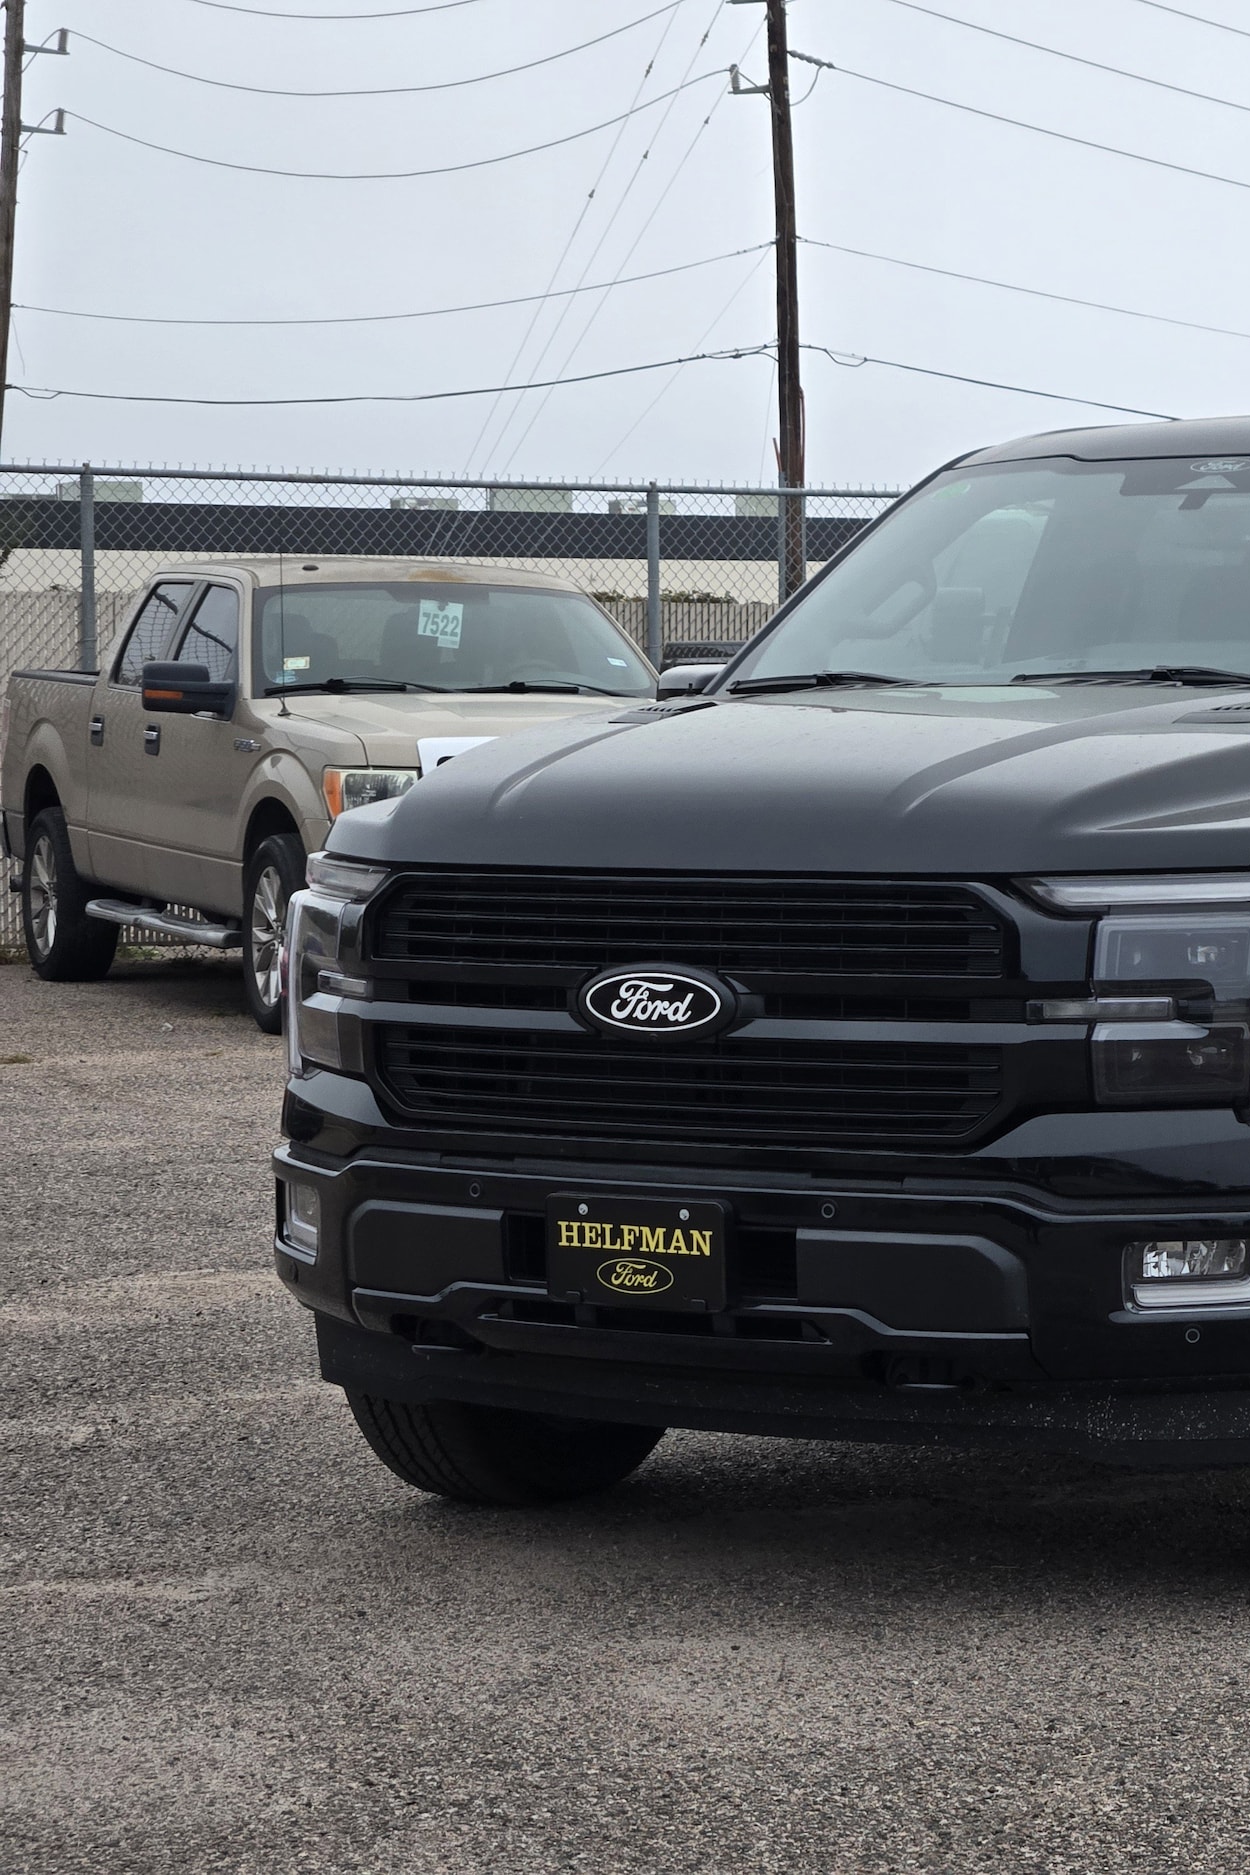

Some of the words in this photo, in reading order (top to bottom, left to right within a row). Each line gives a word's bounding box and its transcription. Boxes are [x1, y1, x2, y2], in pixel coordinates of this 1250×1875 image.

[422, 612, 460, 637] 7522
[611, 980, 694, 1022] Ford
[557, 1220, 713, 1256] HELFMAN
[611, 1261, 658, 1288] Ford
